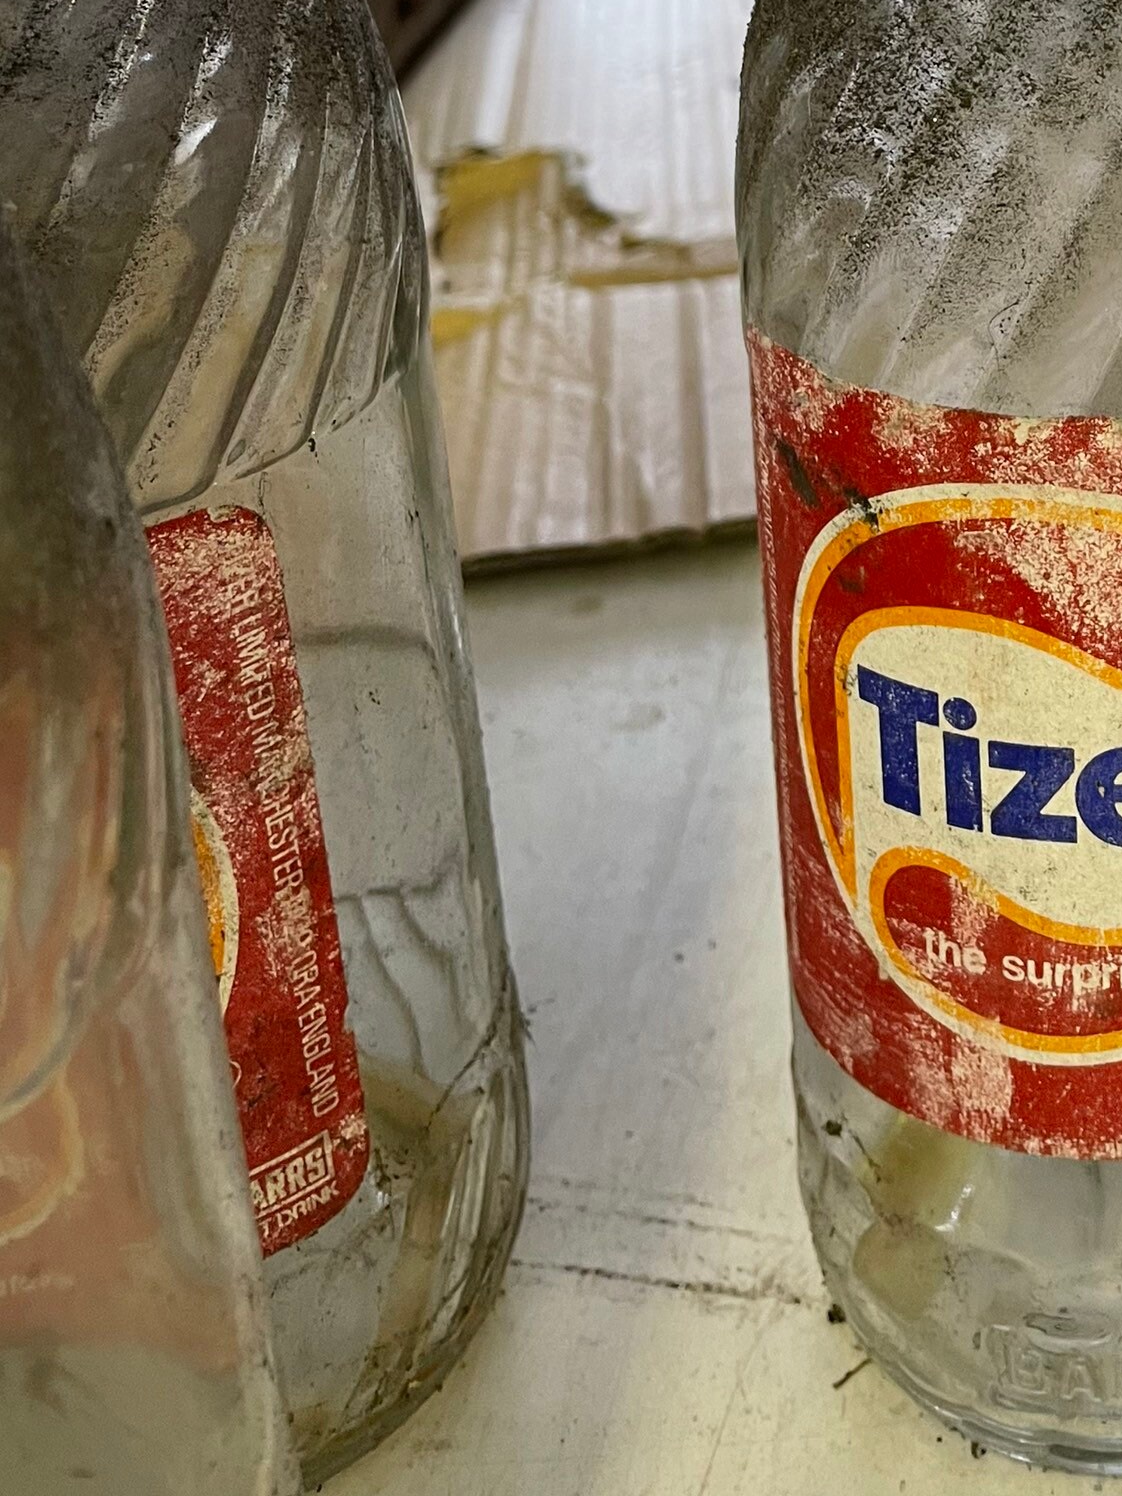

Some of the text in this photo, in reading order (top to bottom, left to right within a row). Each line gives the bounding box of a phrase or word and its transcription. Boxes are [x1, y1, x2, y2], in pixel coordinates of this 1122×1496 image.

[230, 612, 276, 721] LIMITED
[298, 1002, 339, 1118] ENGLAND
[923, 928, 986, 975] the
[251, 1147, 325, 1209] ARRS
